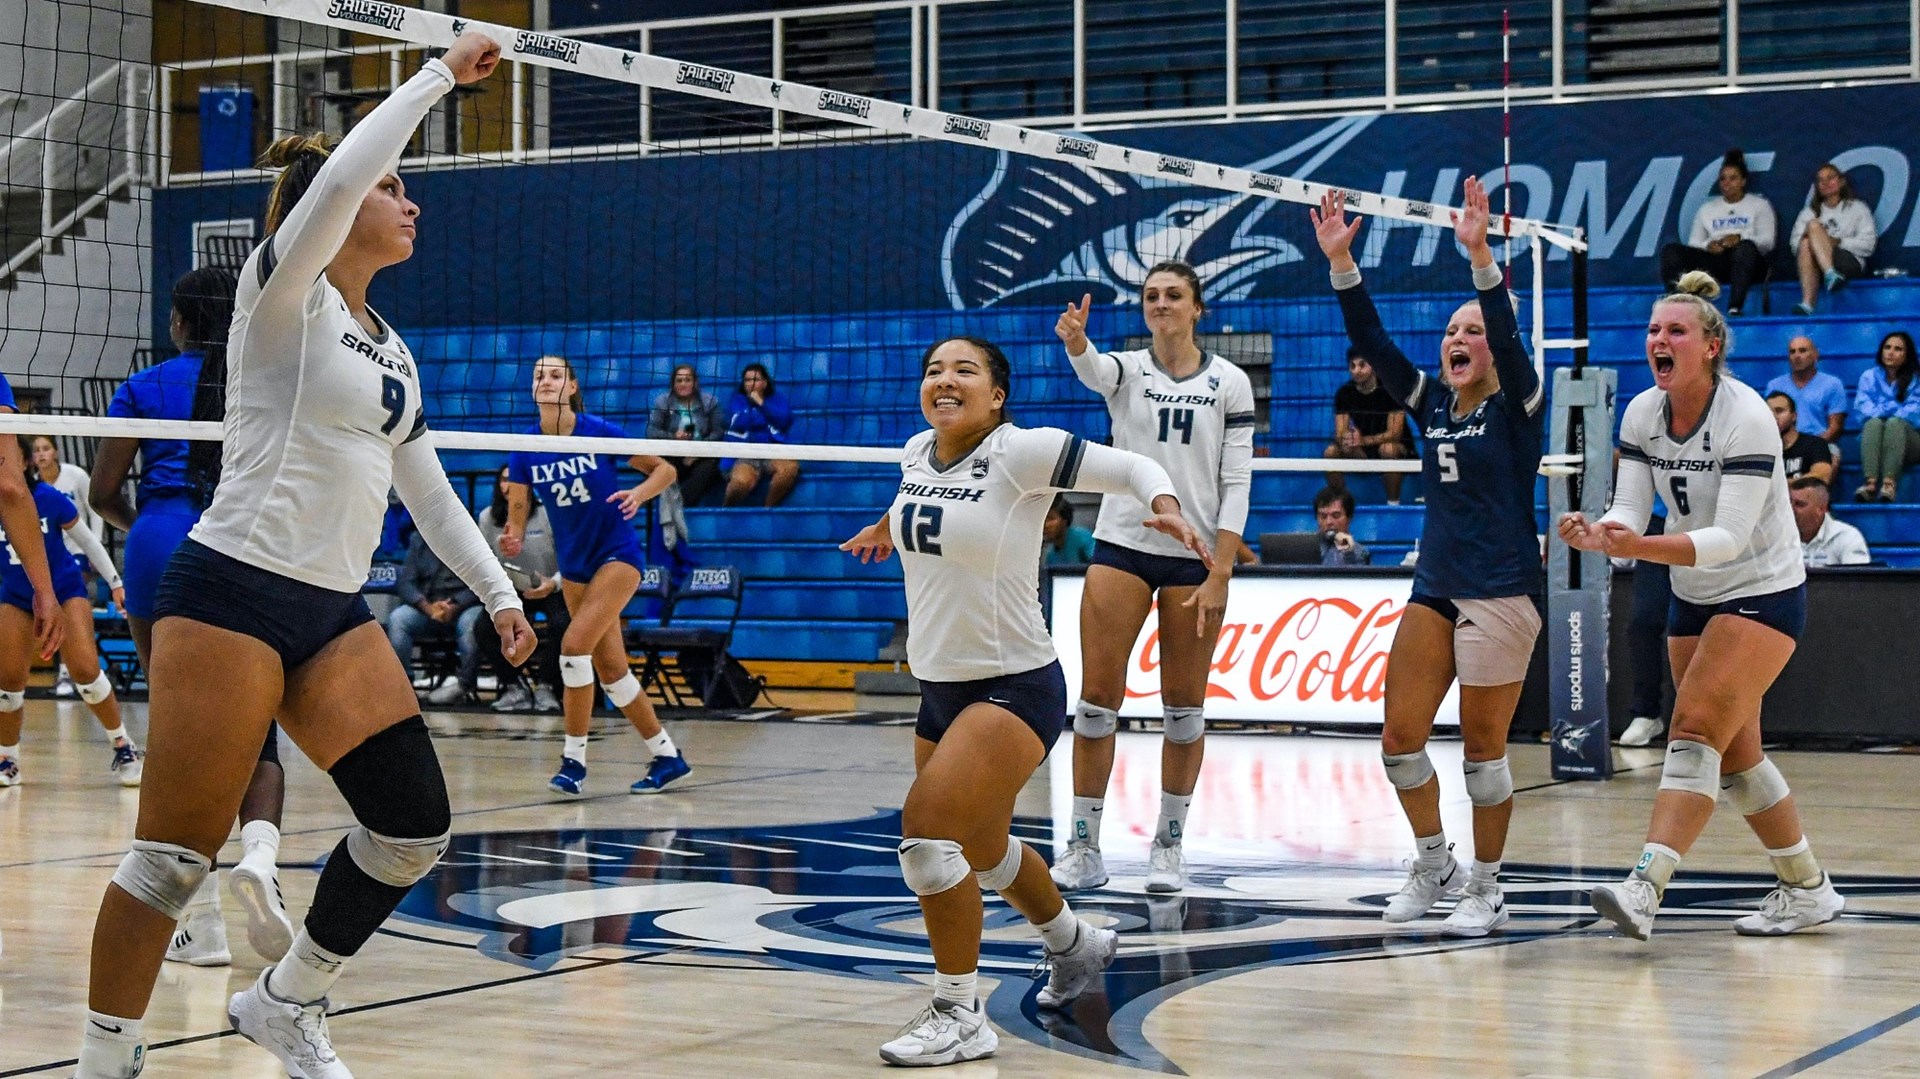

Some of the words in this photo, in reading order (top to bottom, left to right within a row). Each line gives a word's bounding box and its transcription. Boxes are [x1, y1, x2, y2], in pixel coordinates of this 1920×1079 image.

[328, 0, 405, 31] SAILFISH
[339, 11, 387, 28] VOLLEYBALL
[514, 31, 581, 64] SAILFISH
[523, 45, 566, 60] VOLLEYBALL
[677, 63, 735, 94] SAILFISH
[818, 90, 870, 119] SAILFISH
[944, 115, 990, 140] SAILFISH
[1056, 136, 1098, 160] SAILFISH
[1157, 154, 1195, 178] SAILFISH
[1249, 173, 1283, 193] SAILFISH
[340, 332, 412, 379] SAILFIS
[381, 373, 406, 437] 9
[1143, 388, 1217, 407] SAILFISH
[1157, 407, 1195, 445] 14
[531, 453, 598, 484] LYNN
[1437, 442, 1460, 482] 5
[1648, 456, 1715, 472] SAILFISH
[550, 477, 592, 508] 24
[1669, 476, 1691, 517] 6
[900, 502, 945, 557] 12
[1568, 611, 1583, 656] sports
[1568, 657, 1583, 712] imports
